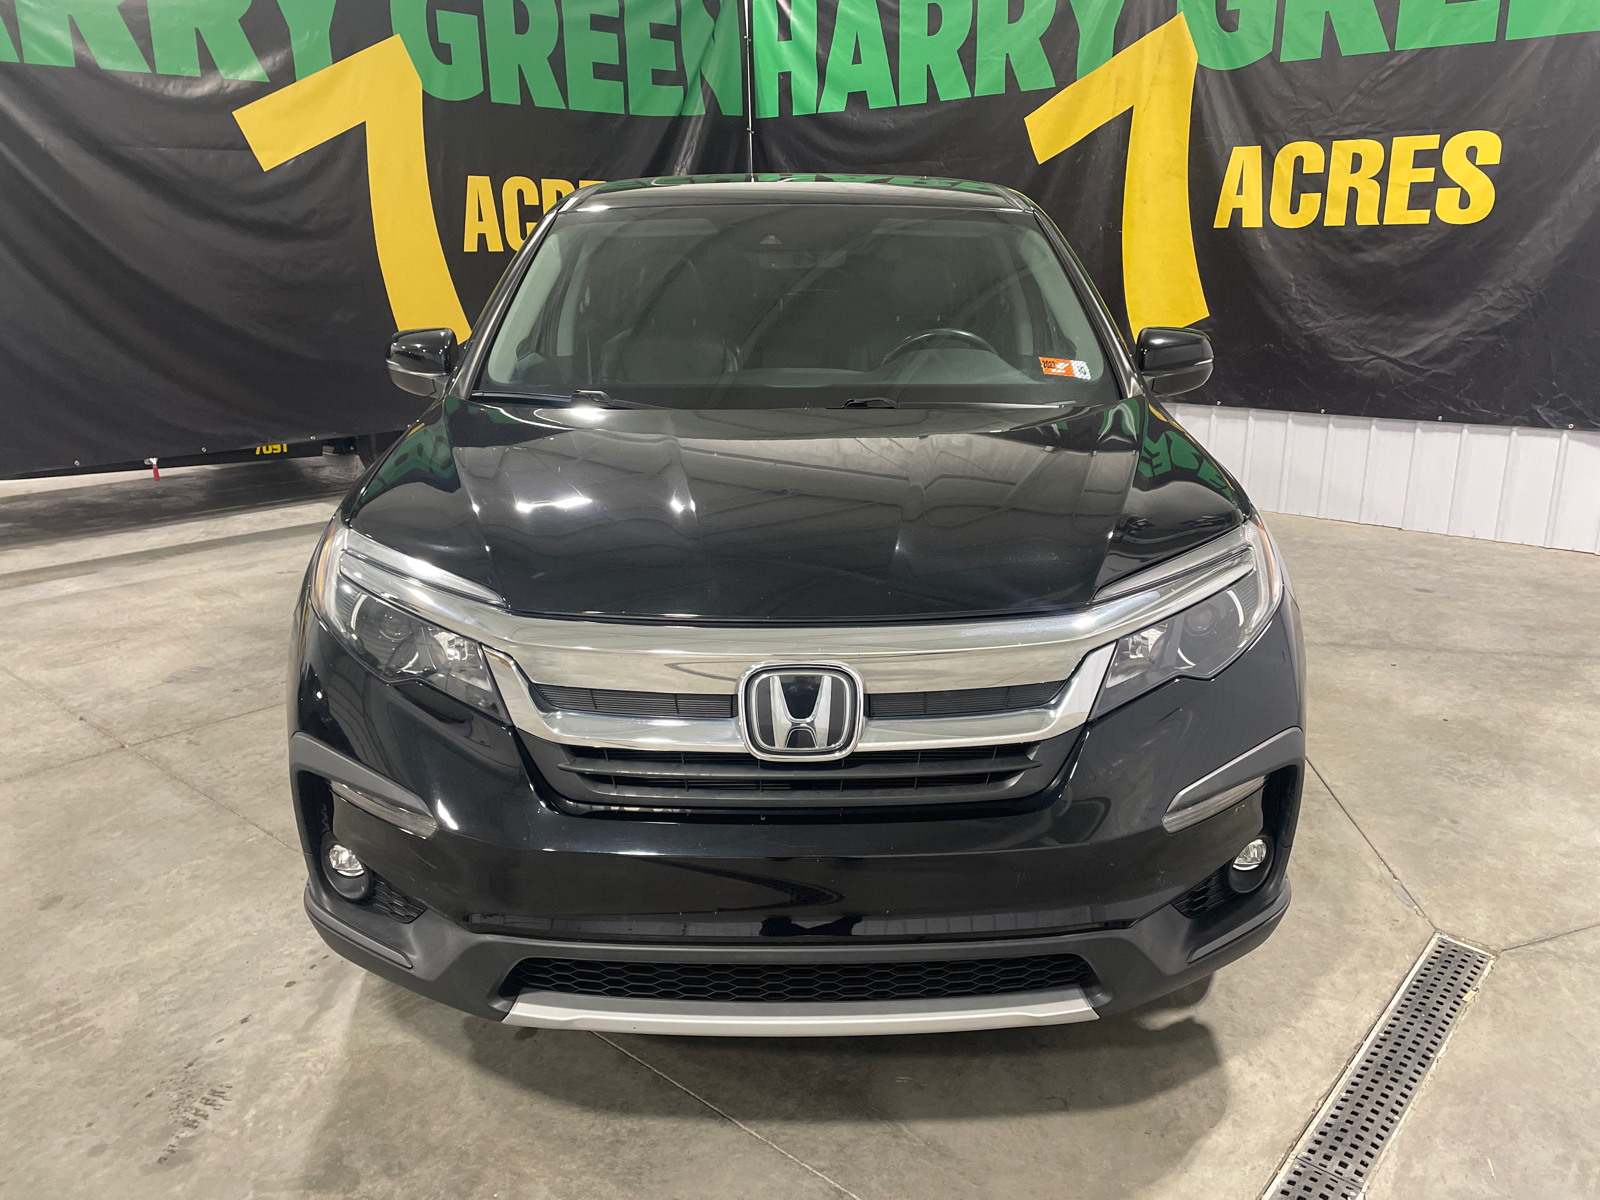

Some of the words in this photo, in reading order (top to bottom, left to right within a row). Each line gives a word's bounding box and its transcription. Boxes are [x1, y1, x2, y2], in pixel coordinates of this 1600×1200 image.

[390, 0, 743, 117] GREEN
[753, 0, 1124, 119] HARRY
[232, 34, 472, 345] 7
[1024, 12, 1210, 344] 7
[1213, 130, 1502, 228] ACRES
